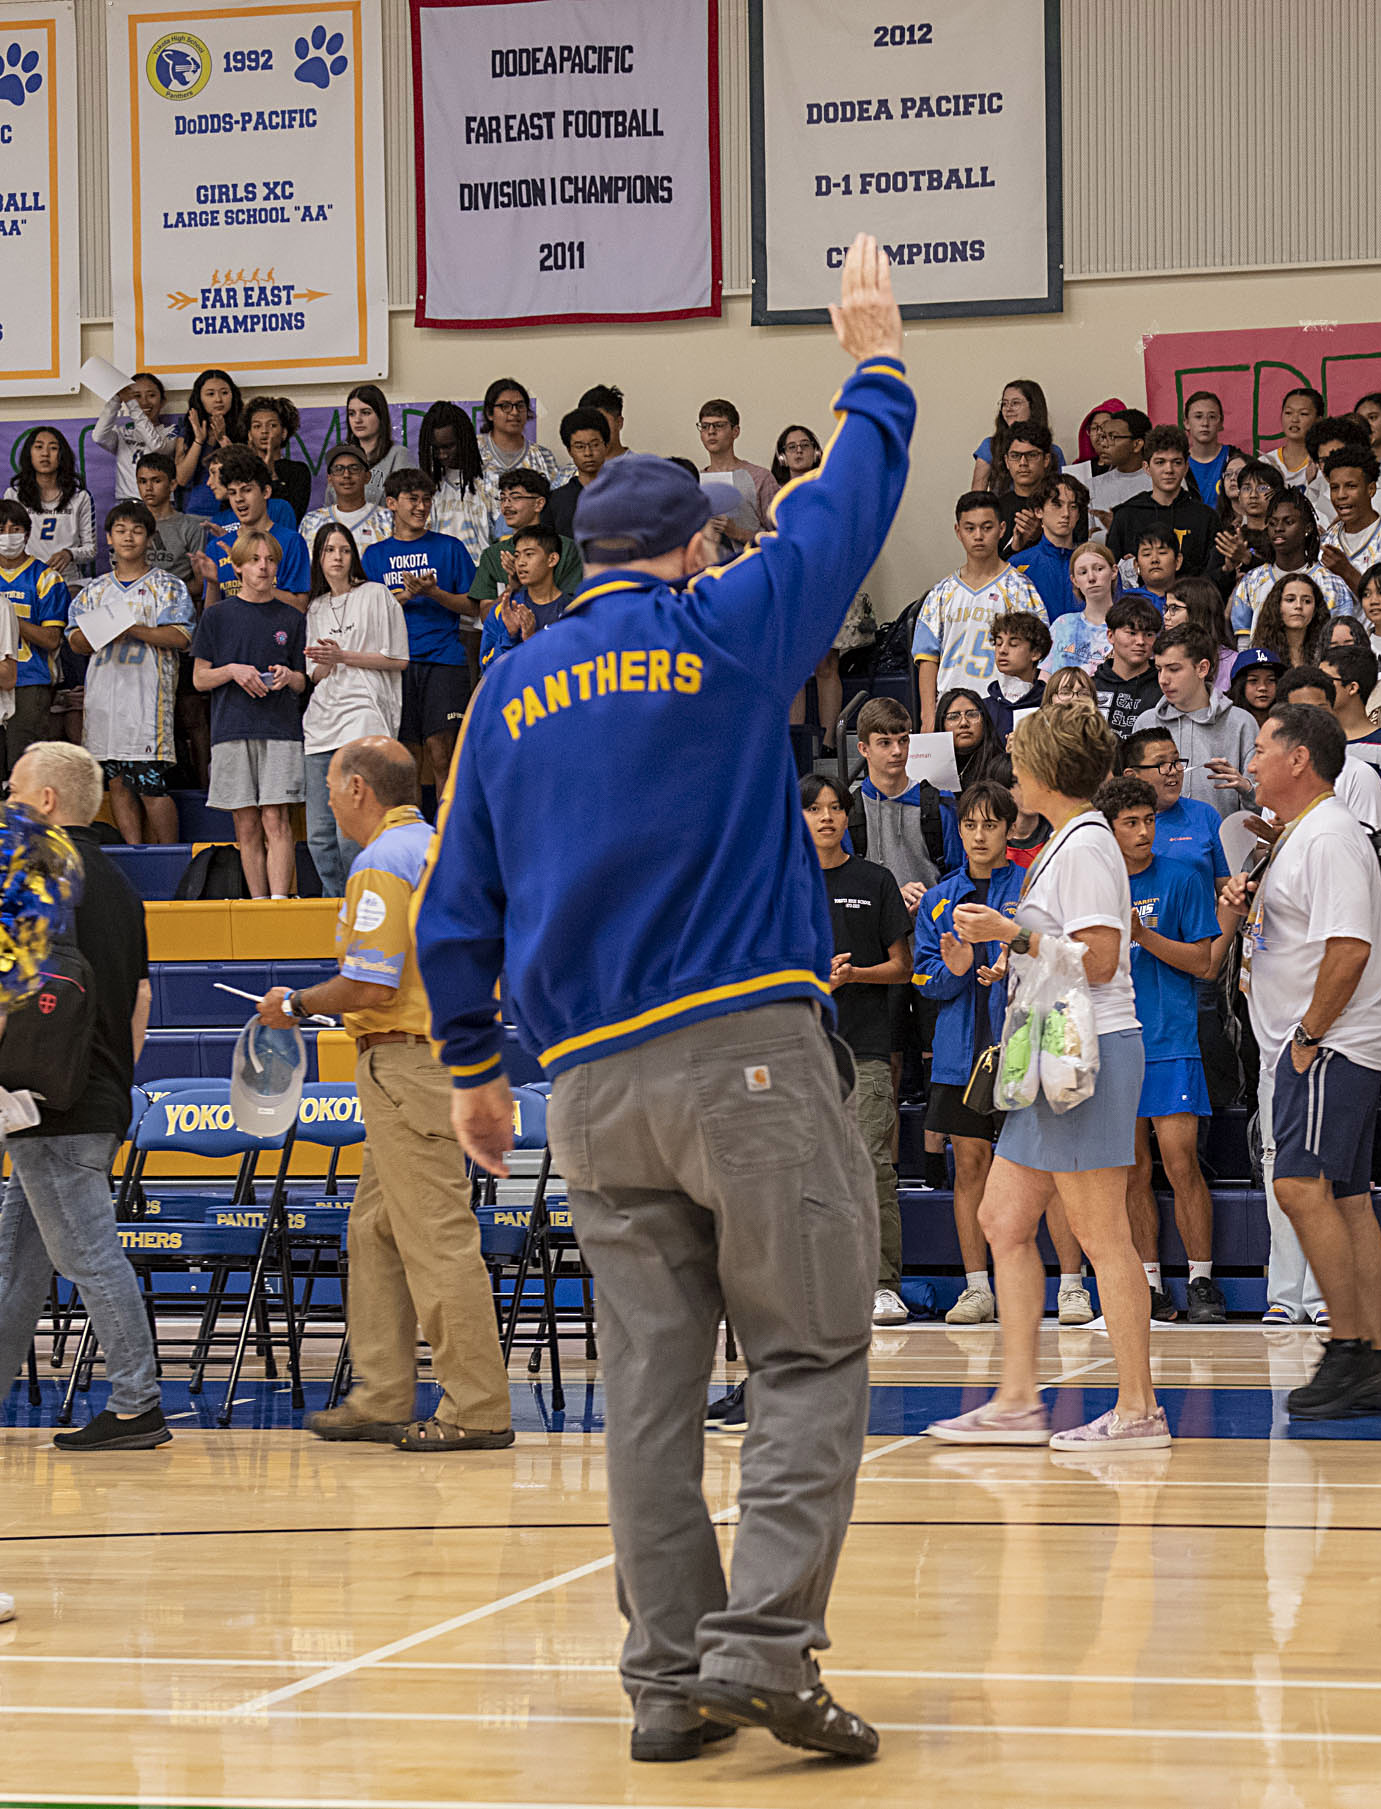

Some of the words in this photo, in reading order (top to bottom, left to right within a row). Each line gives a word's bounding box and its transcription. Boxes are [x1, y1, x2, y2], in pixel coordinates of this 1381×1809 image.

[873, 23, 933, 48] 2012
[223, 49, 273, 73] 1992
[174, 108, 317, 136] DoDDS-PACIFIC
[806, 98, 893, 126] DODEA
[900, 92, 1004, 120] PACIFIC
[464, 115, 501, 145] FAR
[503, 112, 555, 143] EAST
[562, 108, 664, 140] FOOTBALL
[195, 182, 257, 205] GIRLS
[262, 180, 294, 201] XC
[458, 178, 546, 212] DIVISION
[560, 174, 673, 205] CHAMPIONS
[814, 174, 852, 197] D-1
[859, 166, 995, 195] FOOTBALL
[163, 210, 220, 229] LARGE
[224, 207, 290, 227] SCHOOL
[538, 241, 586, 272] 2011
[826, 239, 986, 269] CMPIONS
[200, 286, 239, 309] FAR
[243, 284, 295, 308] EAST
[191, 311, 306, 336] CHAMPIONS
[40, 518, 57, 541] 2
[388, 552, 429, 570] YOKOTA
[382, 568, 438, 587] WRETLING
[941, 628, 997, 680] 45
[1255, 649, 1268, 662] LA
[502, 648, 704, 740] PANTHERS
[164, 1103, 240, 1137] YOKO
[299, 1096, 365, 1125] OKOT
[118, 1231, 183, 1249] THERS
